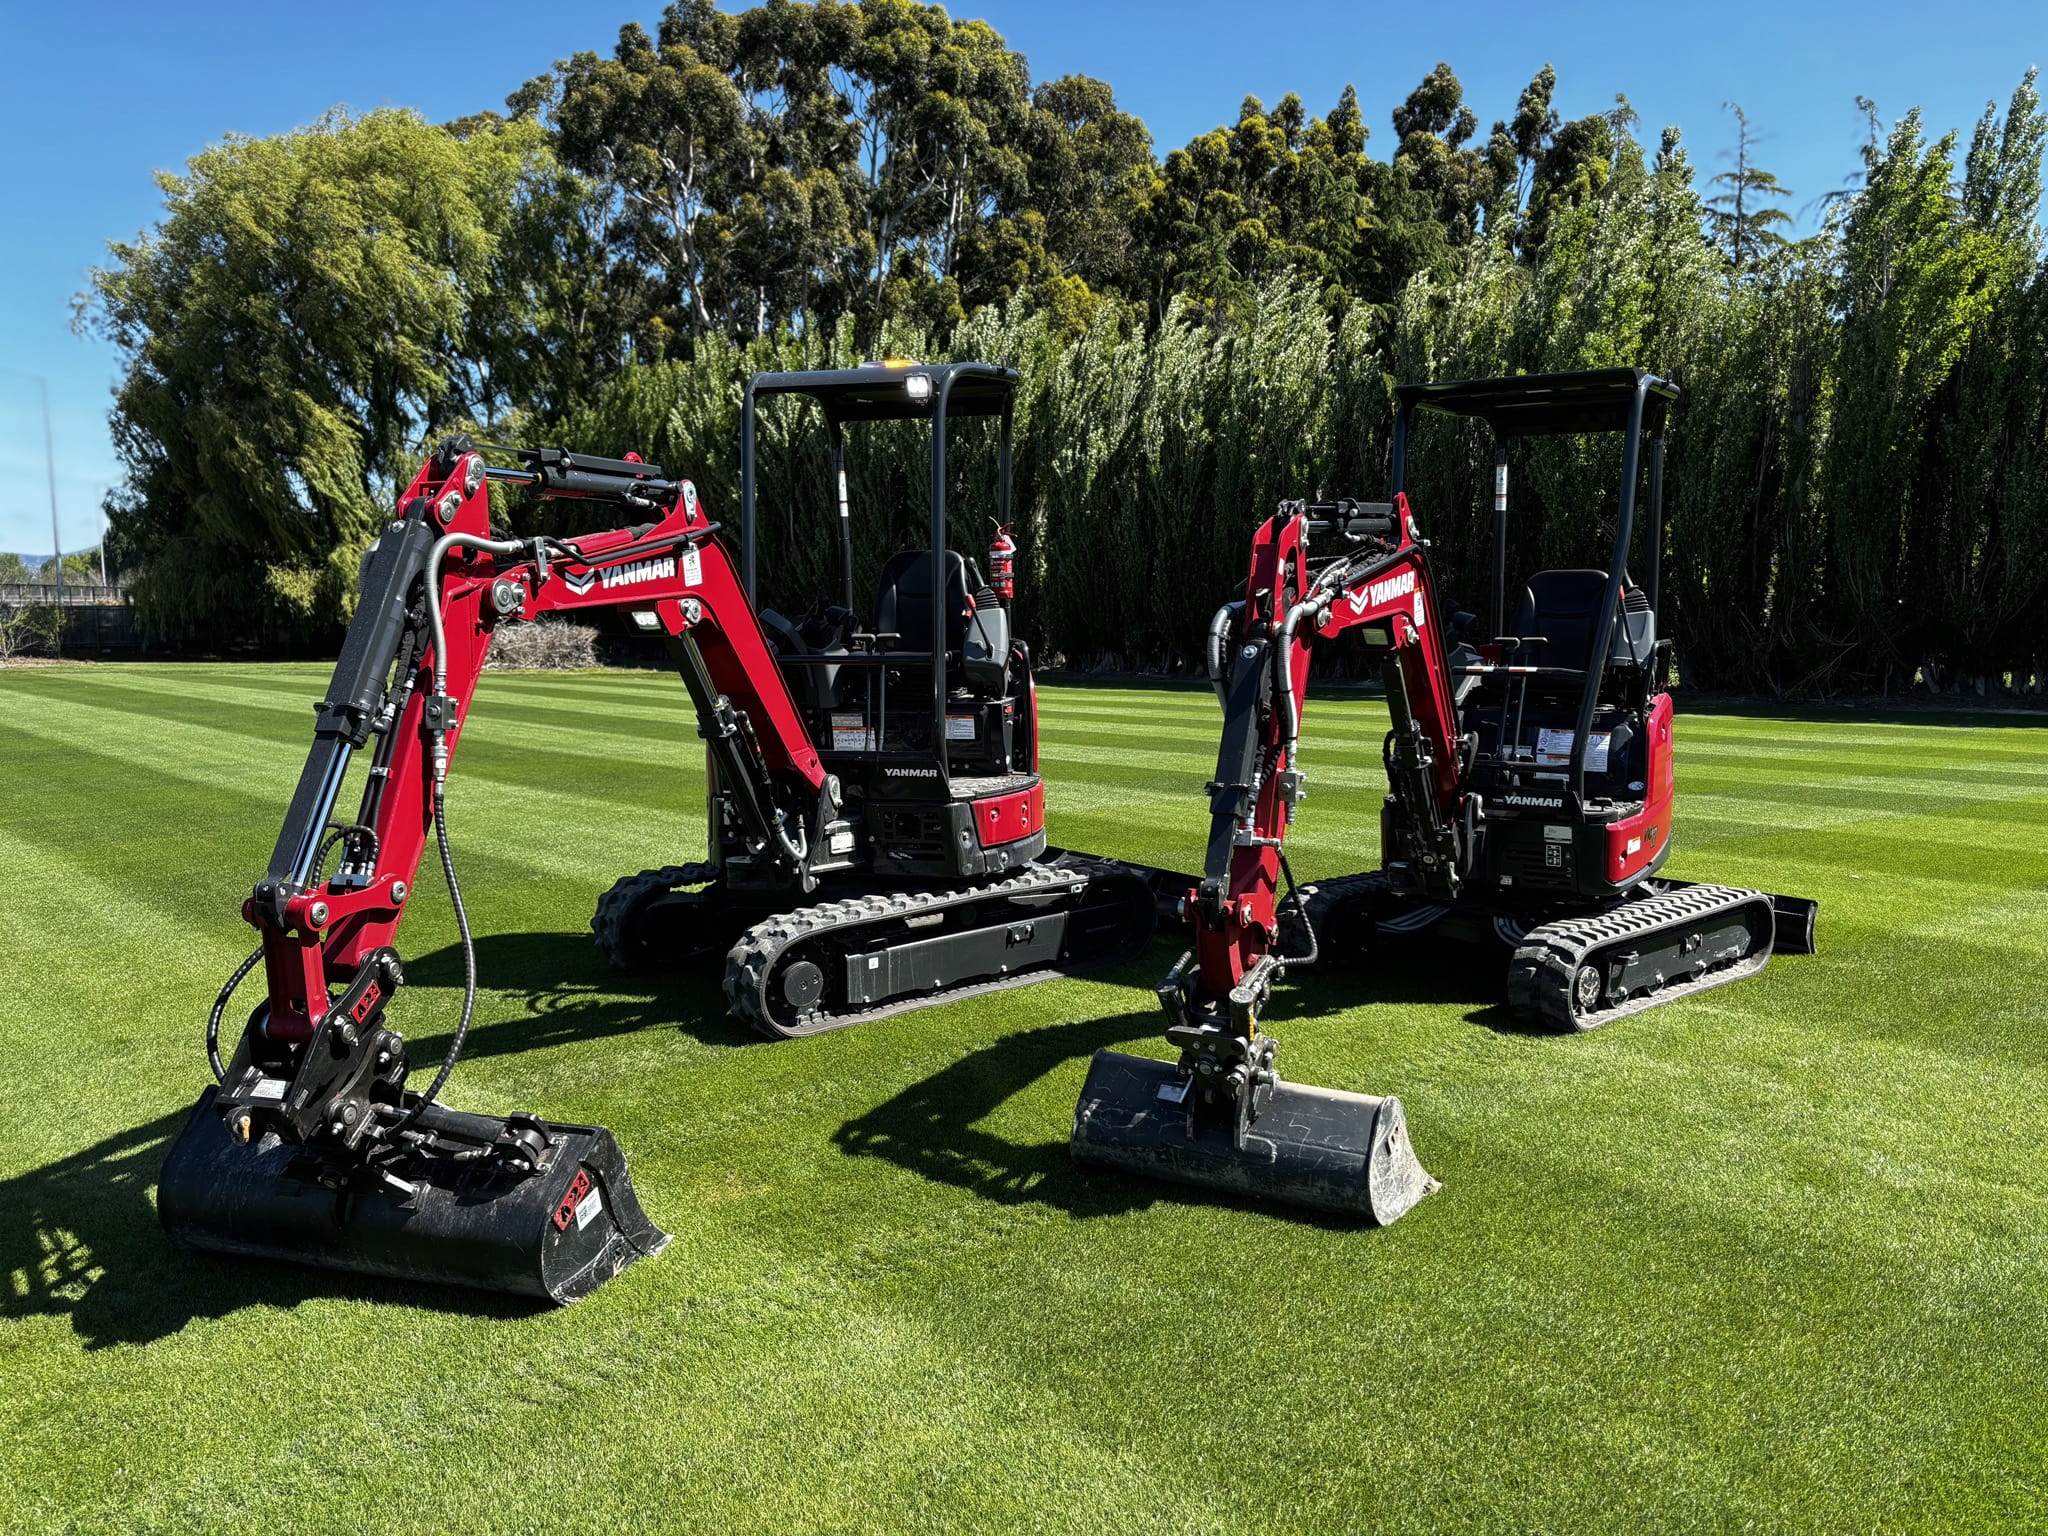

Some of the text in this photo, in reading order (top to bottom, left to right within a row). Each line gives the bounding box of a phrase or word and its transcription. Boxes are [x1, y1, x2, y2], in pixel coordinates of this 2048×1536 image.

[599, 557, 675, 589] YANMAR
[1369, 570, 1415, 607] YANMAR
[884, 768, 938, 778] YANMAR
[1504, 795, 1563, 808] YANMAR
